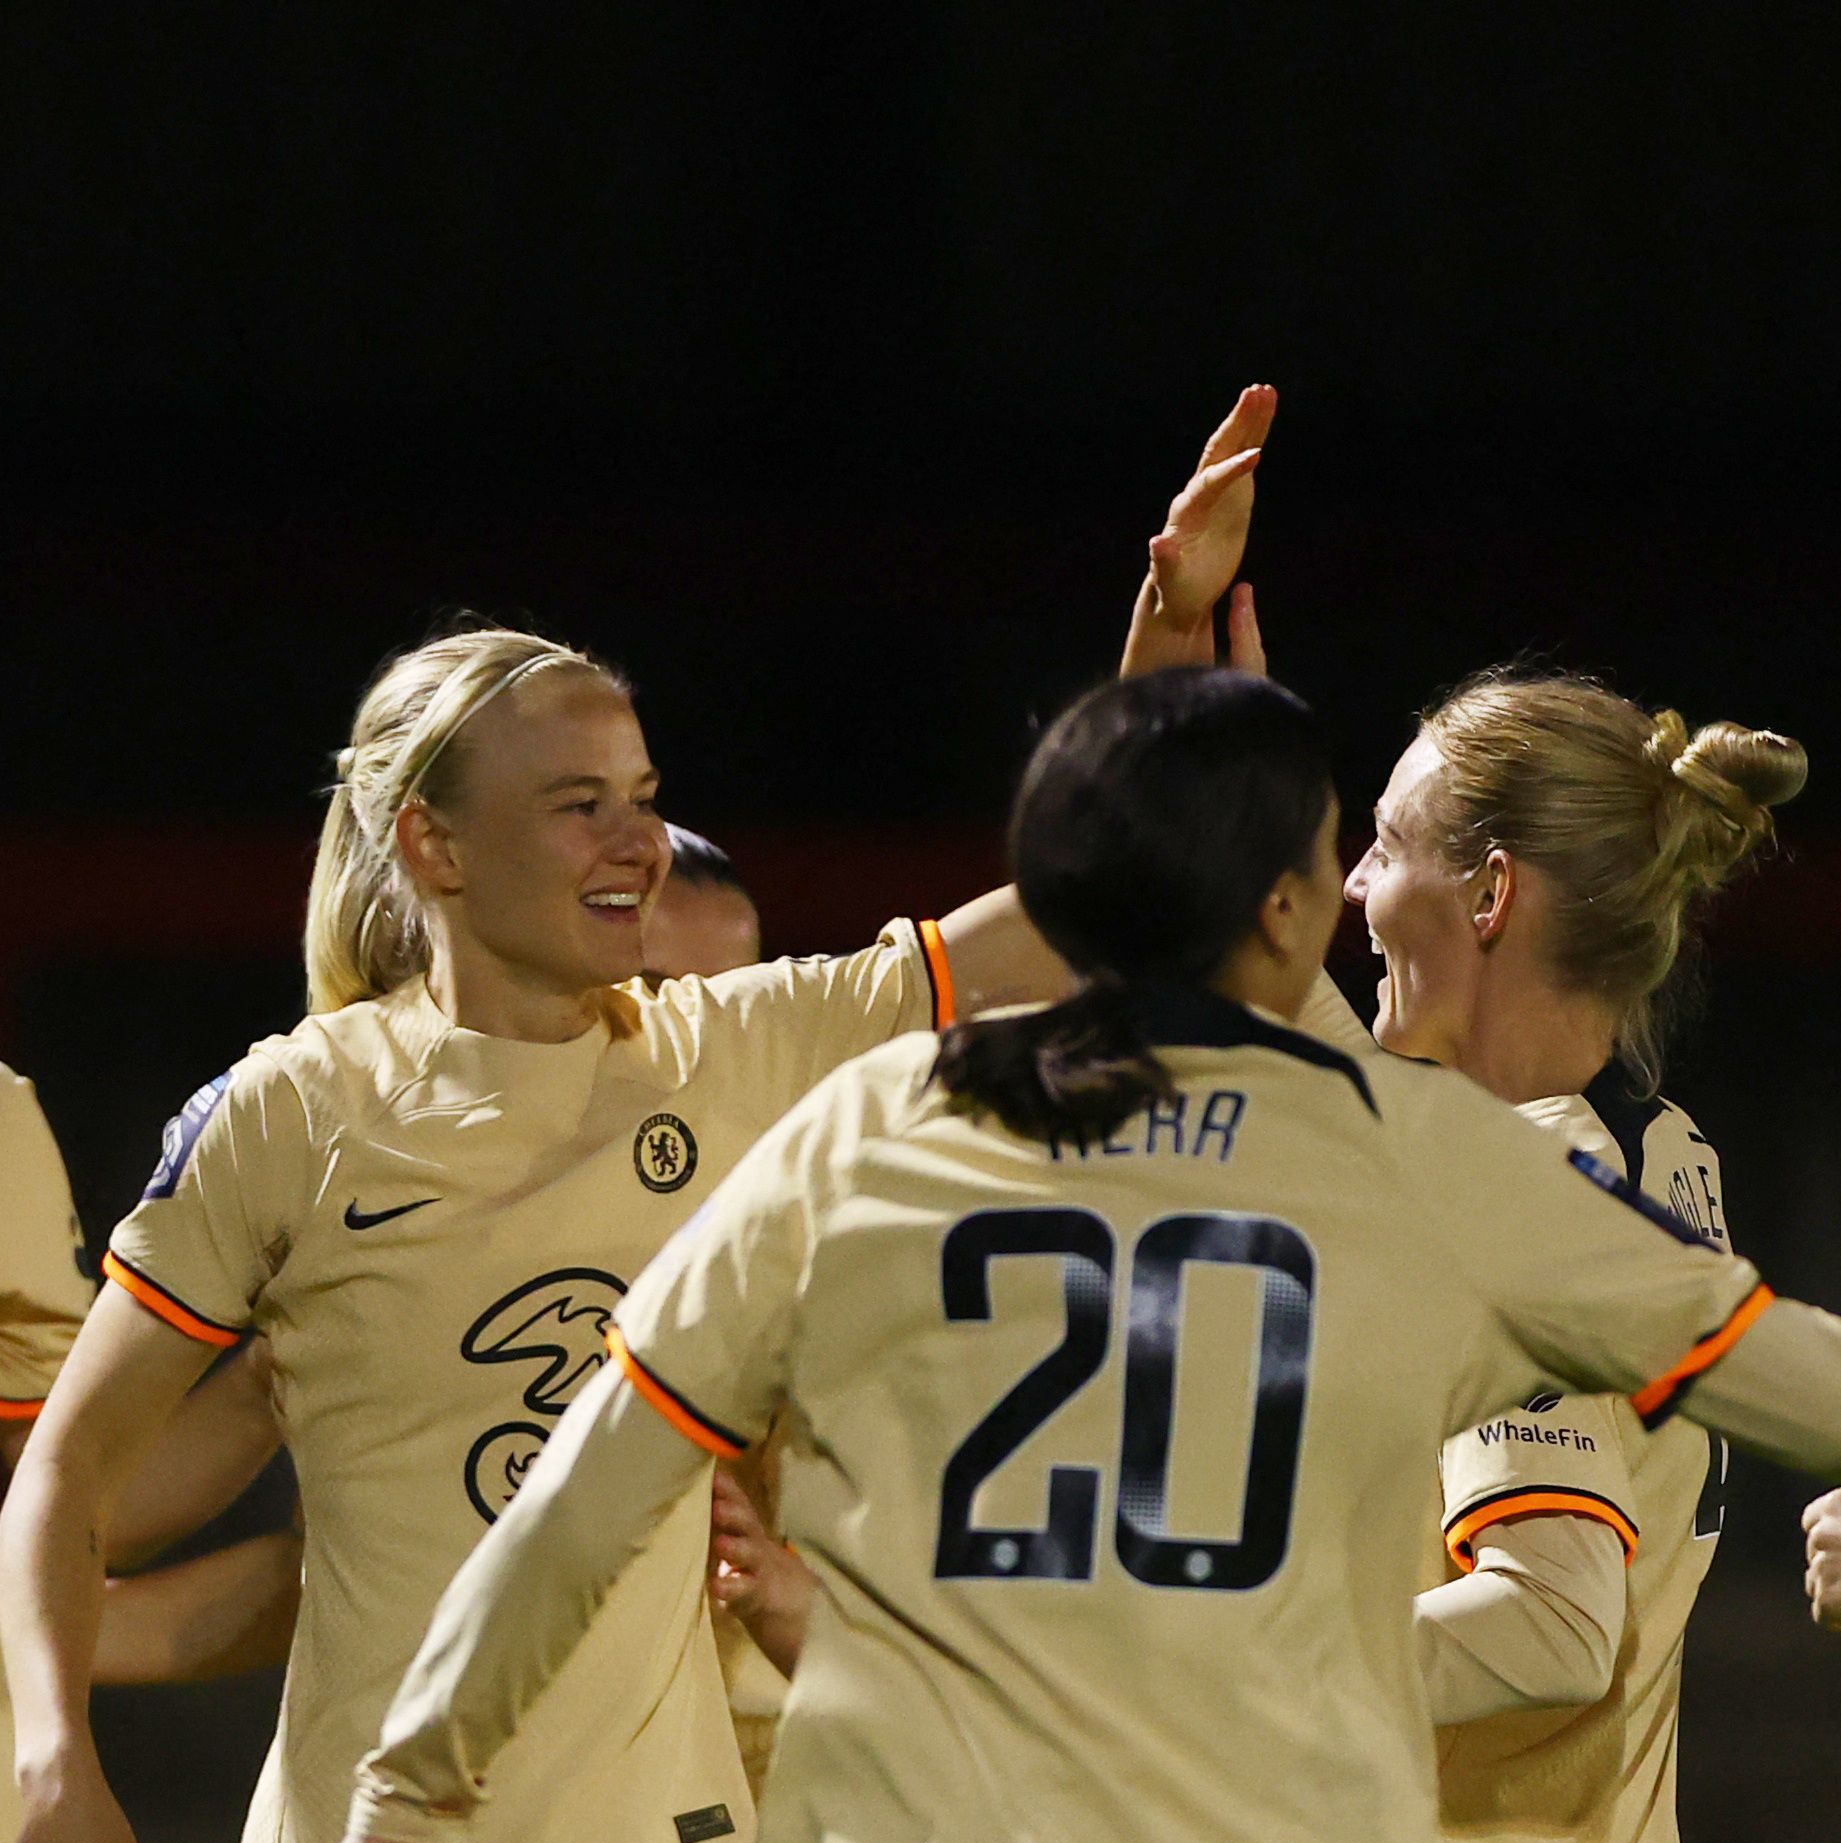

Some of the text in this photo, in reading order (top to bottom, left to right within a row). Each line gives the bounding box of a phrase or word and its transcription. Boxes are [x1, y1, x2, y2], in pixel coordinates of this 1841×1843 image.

[1050, 1089, 1248, 1162] RR
[933, 1207, 1317, 1592] 20
[1478, 1419, 1597, 1453] WhaleFin
